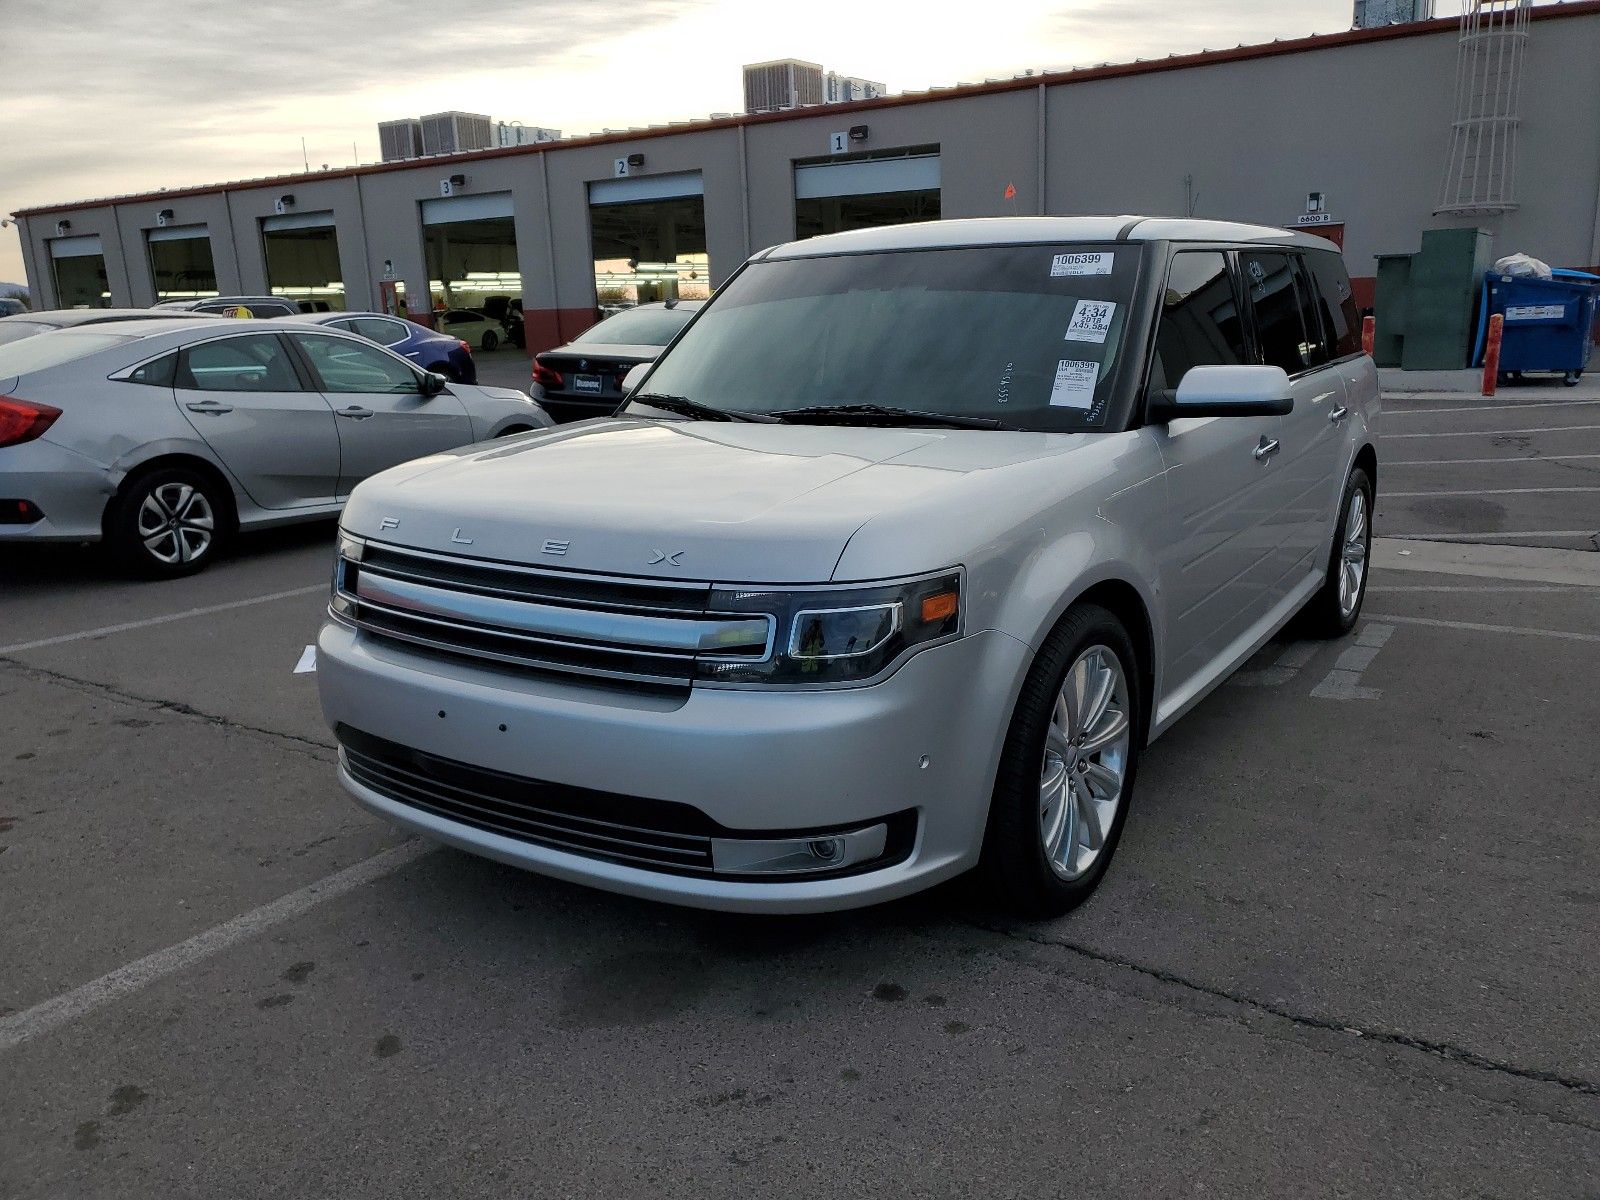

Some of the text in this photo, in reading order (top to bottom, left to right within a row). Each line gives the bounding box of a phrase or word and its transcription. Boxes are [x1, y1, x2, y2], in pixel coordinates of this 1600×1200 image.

[835, 136, 843, 150] 1
[618, 161, 626, 174] 2
[443, 182, 450, 193] 3
[1300, 215, 1321, 223] 6600
[1055, 254, 1101, 265] 1006399
[1060, 361, 1095, 369] 1006399
[379, 516, 685, 567] FLEX
